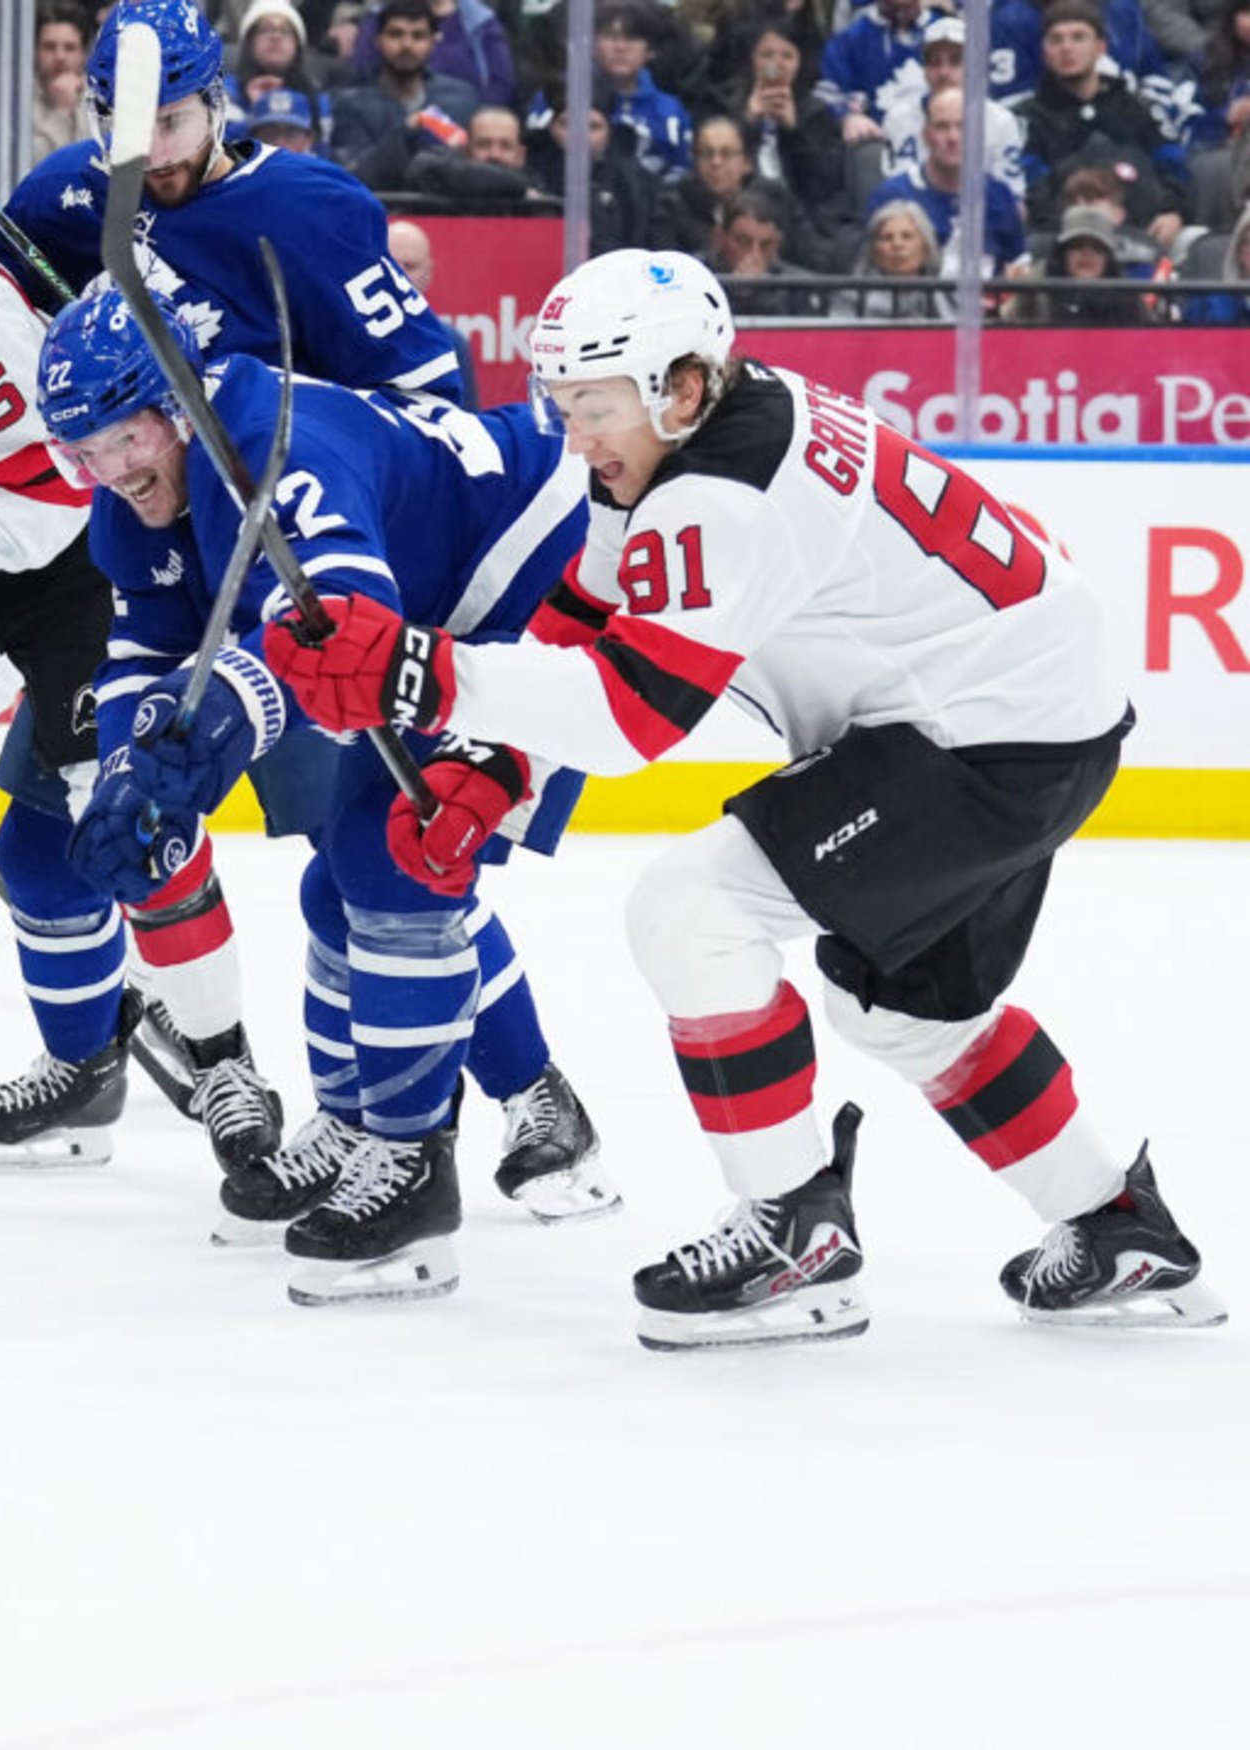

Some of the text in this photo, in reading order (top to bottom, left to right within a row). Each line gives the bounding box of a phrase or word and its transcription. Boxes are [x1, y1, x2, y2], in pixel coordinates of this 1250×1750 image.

[439, 295, 535, 363] nk
[47, 360, 73, 392] 22
[863, 370, 1250, 445] Scotia Pe
[49, 403, 90, 423] CCM
[617, 524, 713, 615] 81
[1145, 526, 1250, 673] R
[390, 626, 431, 735] CCM
[814, 807, 879, 862] CCM
